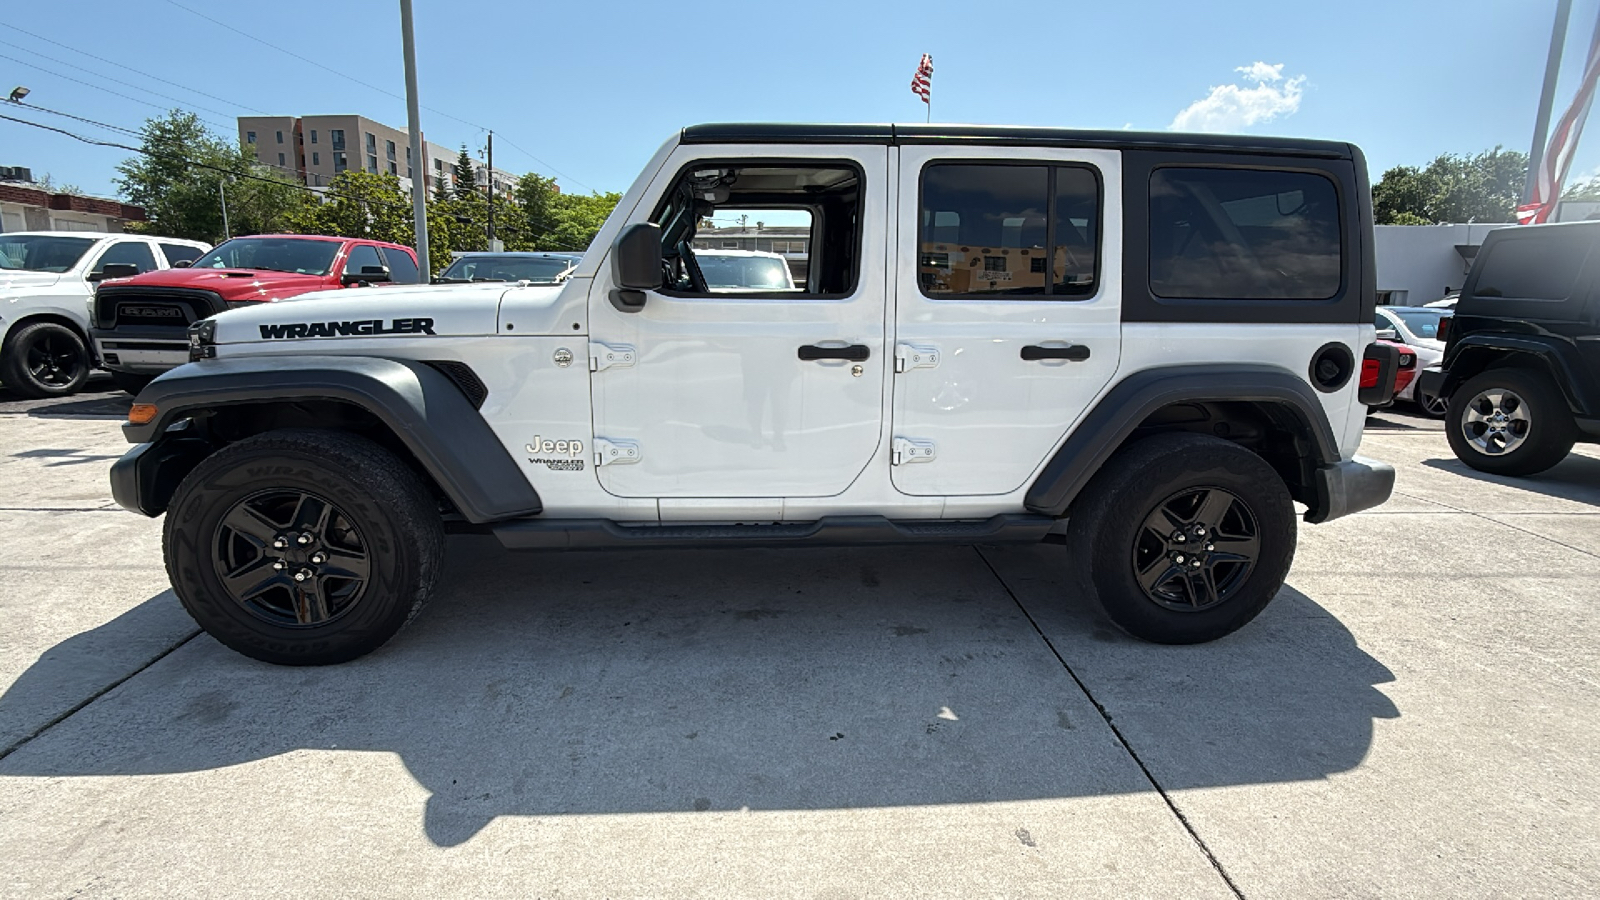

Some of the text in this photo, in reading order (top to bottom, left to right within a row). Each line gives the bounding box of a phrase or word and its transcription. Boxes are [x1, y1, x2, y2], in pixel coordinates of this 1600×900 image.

[124, 308, 178, 317] RAM
[259, 318, 437, 339] WRANGLER
[525, 435, 584, 457] Jeep
[247, 465, 390, 554] WRANGLER
